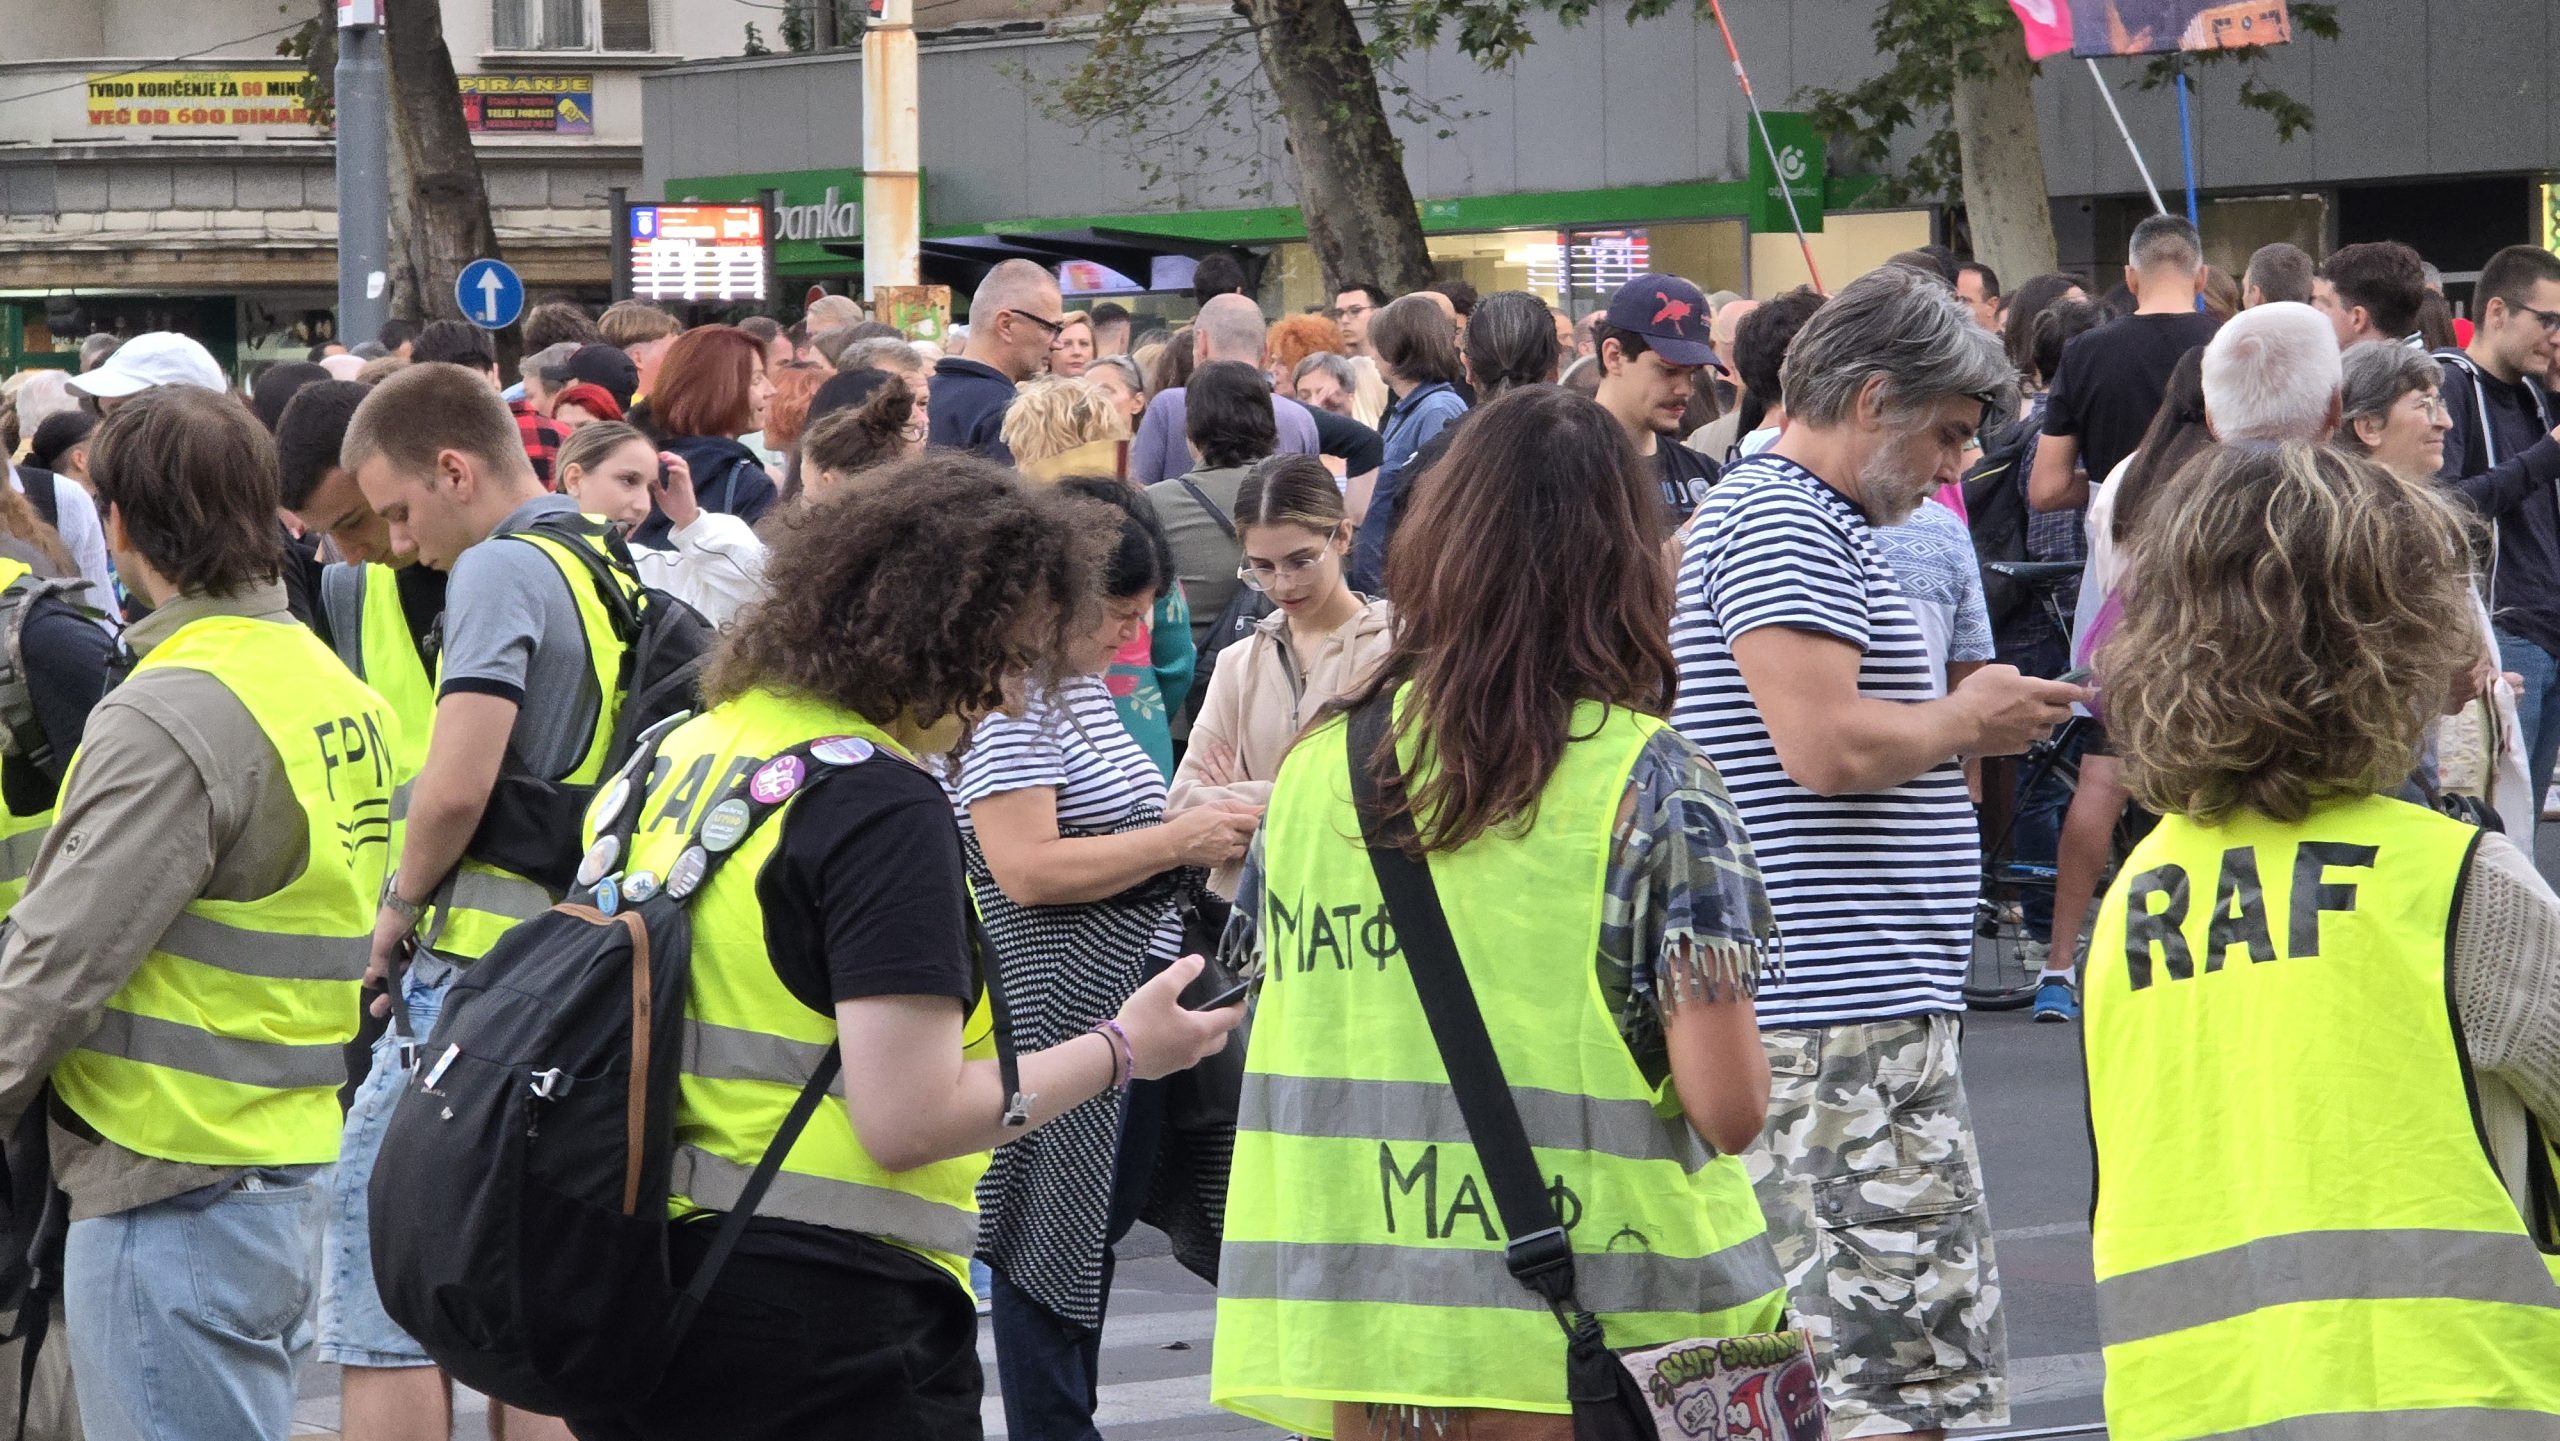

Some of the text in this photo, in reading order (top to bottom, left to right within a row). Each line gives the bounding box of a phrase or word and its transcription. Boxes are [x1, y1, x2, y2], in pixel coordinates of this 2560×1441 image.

[88, 82, 134, 97] TVRDO
[220, 82, 239, 96] ZA
[137, 109, 170, 123] OD
[177, 108, 226, 123] 600
[232, 108, 326, 124] DINAR
[2125, 841, 2380, 991] RAF
[1379, 1141, 1582, 1241] МАФ
